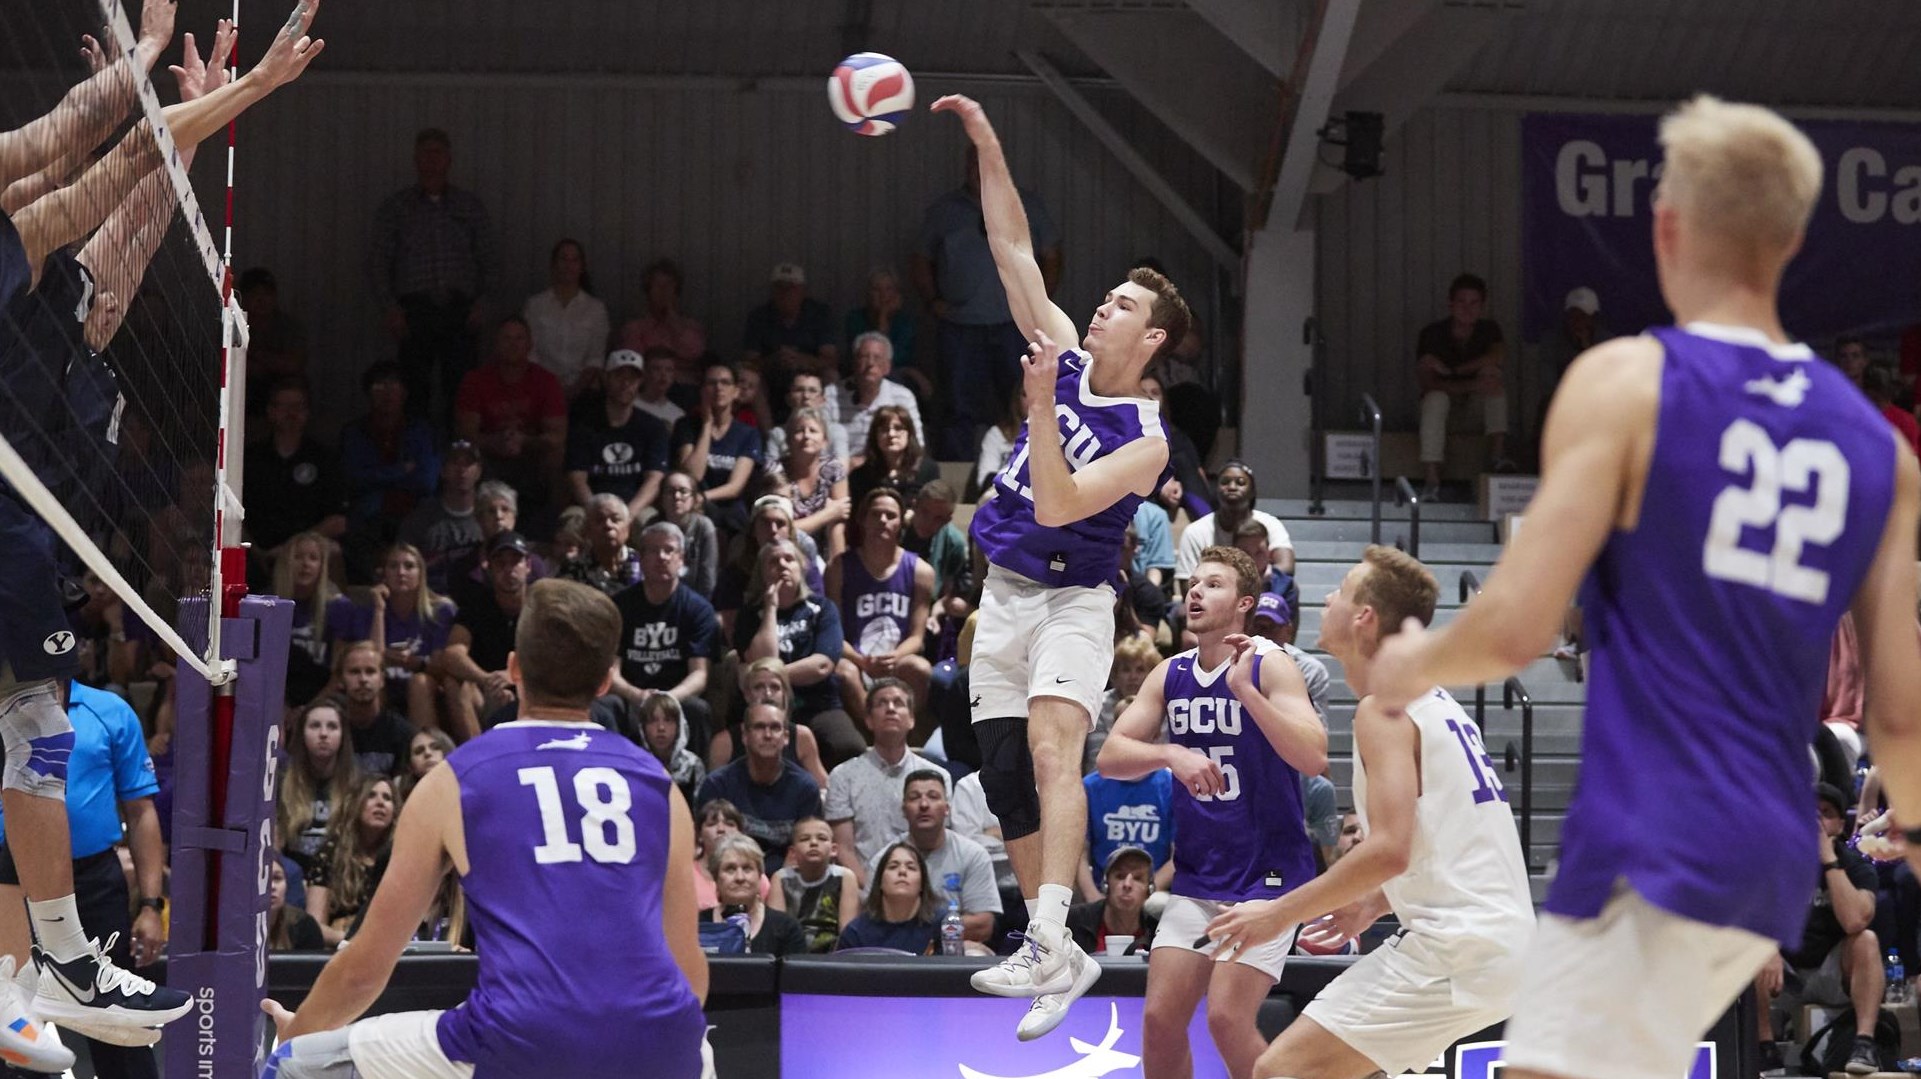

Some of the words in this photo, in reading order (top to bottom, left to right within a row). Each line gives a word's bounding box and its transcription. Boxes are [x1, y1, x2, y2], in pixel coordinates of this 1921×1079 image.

[1053, 396, 1101, 472] CU
[1702, 416, 1850, 606] 22
[856, 592, 911, 618] GCU
[48, 632, 72, 653] Y
[633, 621, 678, 649] BYU
[1167, 697, 1242, 736] GCU
[517, 766, 637, 864] 18
[1107, 820, 1160, 843] BYU
[195, 986, 216, 1056] sports
